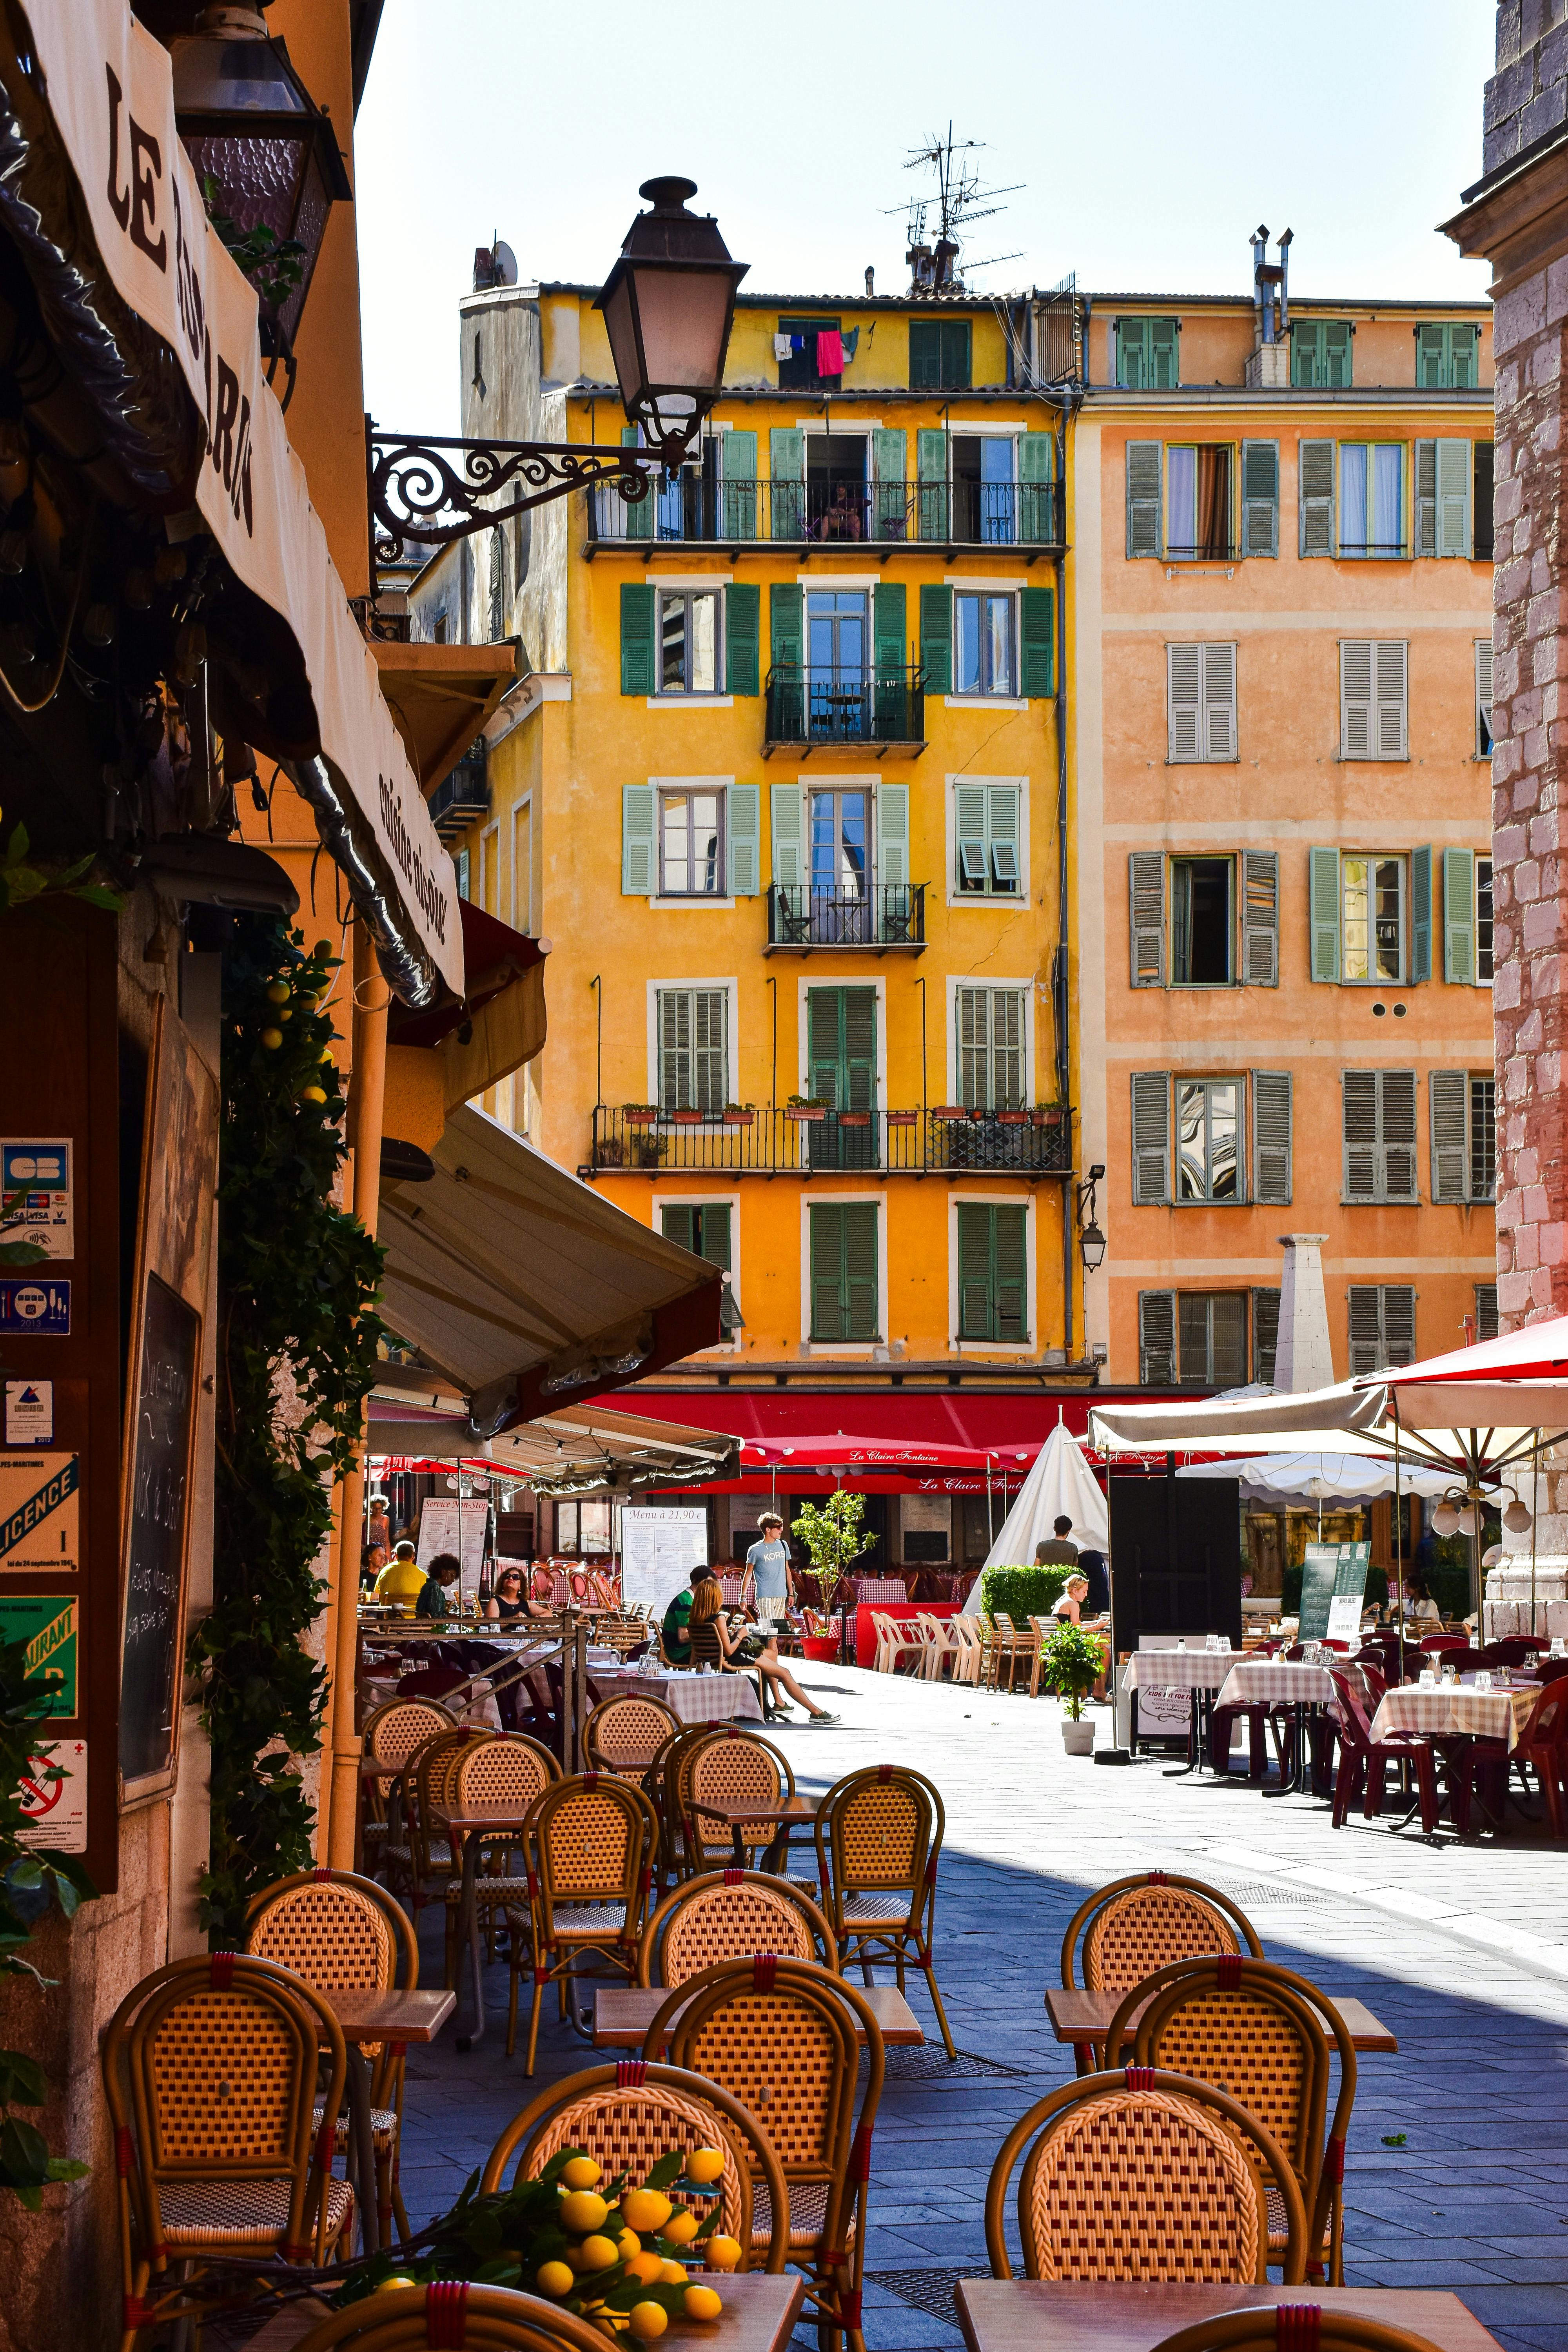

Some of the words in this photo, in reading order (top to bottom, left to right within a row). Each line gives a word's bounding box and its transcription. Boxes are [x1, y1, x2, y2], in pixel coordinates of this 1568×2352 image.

[105, 62, 167, 274] LE
[379, 773, 412, 887] cuisine
[10, 1157, 60, 1178] CB
[849, 1450, 864, 1460] La
[866, 1450, 894, 1460] Claire
[896, 1450, 938, 1461] Fontaine
[918, 1479, 938, 1489] La
[944, 1478, 981, 1490] Claire
[424, 1499, 450, 1508] Service
[451, 1500, 488, 1511] Non-Stop
[629, 1510, 657, 1519] Menu
[660, 1510, 664, 1519] à
[668, 1510, 694, 1521] 21,90
[763, 1550, 785, 1562] KORS
[22, 1608, 73, 1671] AURANT
